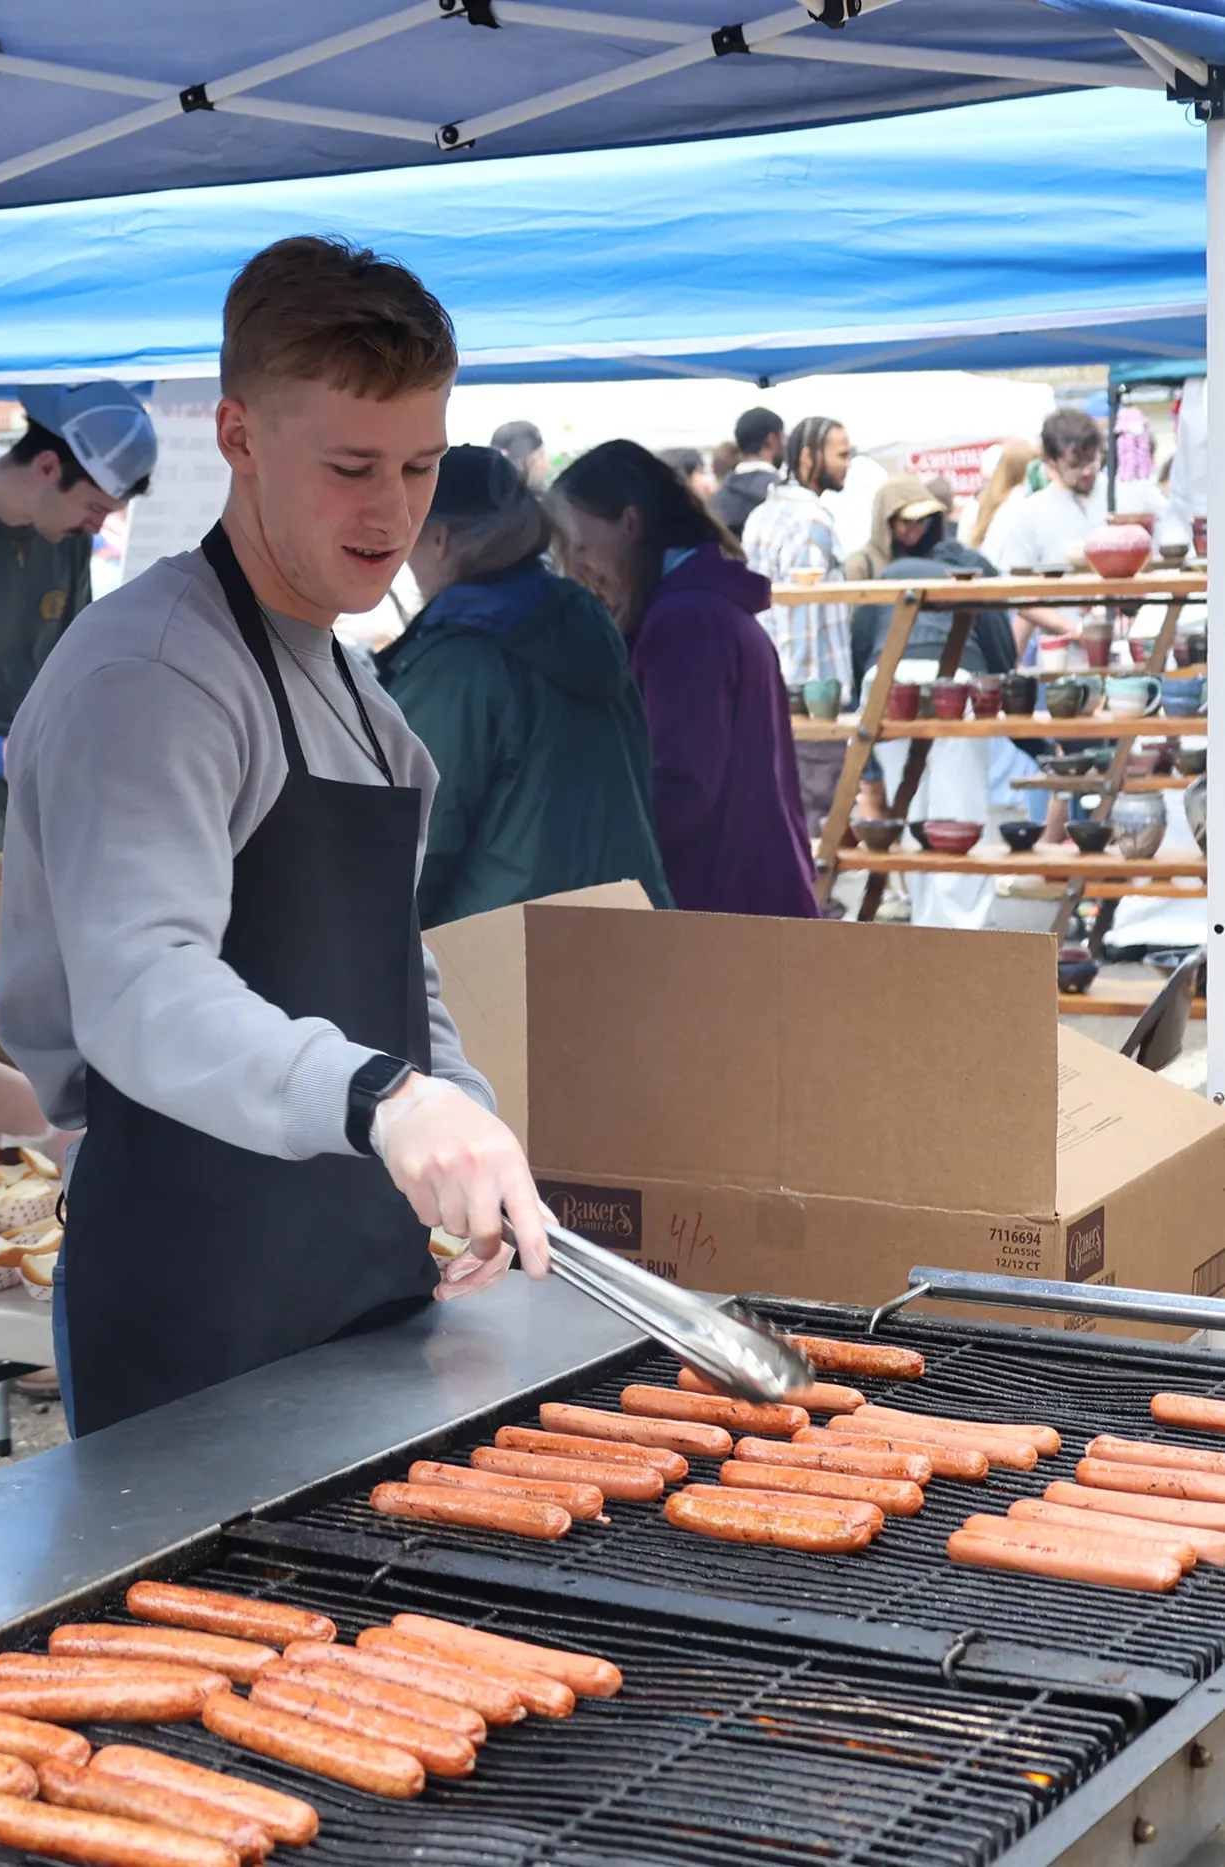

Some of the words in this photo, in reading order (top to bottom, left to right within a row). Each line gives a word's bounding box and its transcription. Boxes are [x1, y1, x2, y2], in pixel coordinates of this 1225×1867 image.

[989, 1228, 1041, 1246] 7116694
[1002, 1245, 1041, 1258] CLASSIC
[995, 1258, 1024, 1270] 12/12
[1026, 1261, 1041, 1271] CT
